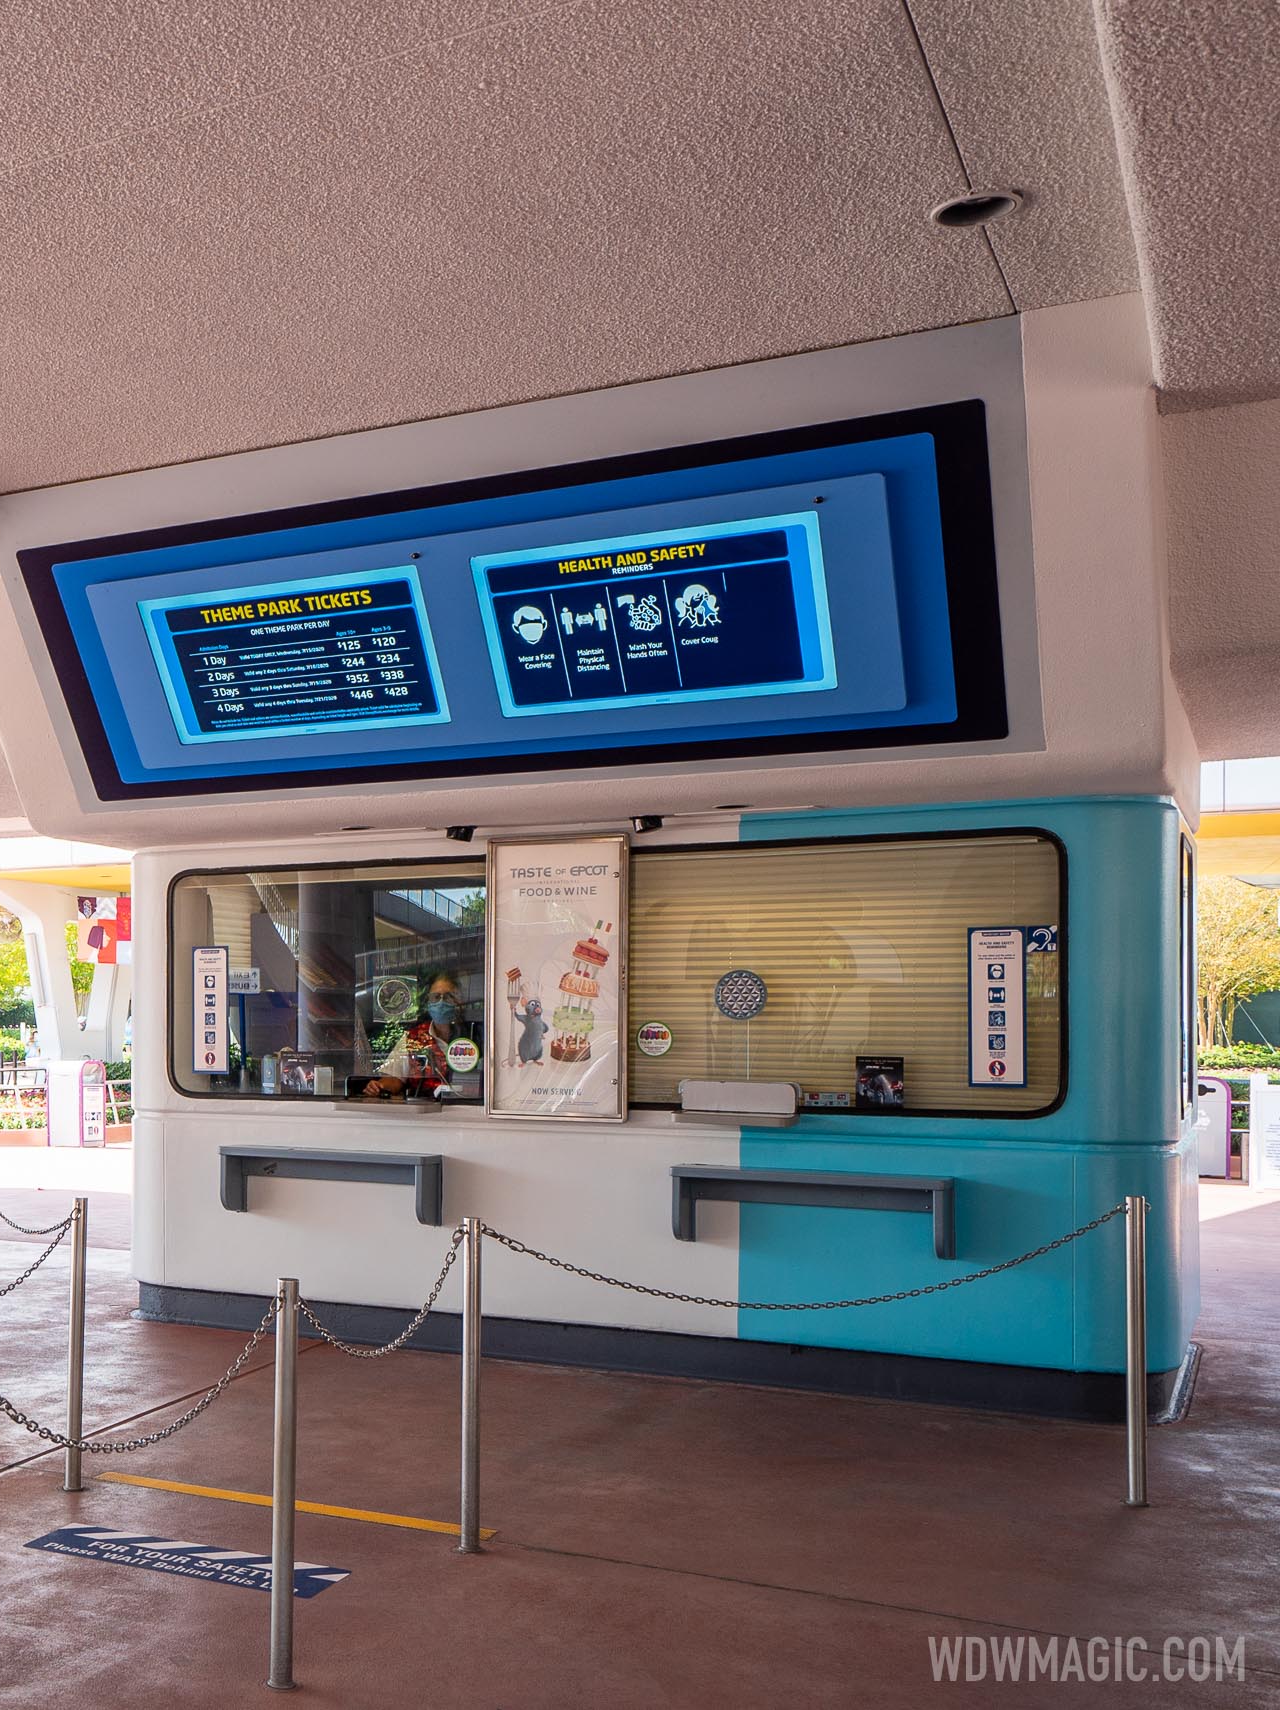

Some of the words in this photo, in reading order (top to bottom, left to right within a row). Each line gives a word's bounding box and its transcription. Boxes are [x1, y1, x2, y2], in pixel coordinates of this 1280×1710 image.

[558, 556, 613, 574] HEALTH
[616, 552, 647, 567] AND
[649, 543, 706, 562] SAFETY
[612, 563, 654, 575] REMINDERS
[200, 604, 255, 624] THEME
[256, 599, 303, 617] PARK
[303, 589, 372, 612] TICKETS
[250, 628, 264, 636] ONE
[264, 625, 286, 635] THEME
[286, 624, 304, 632] PARK
[303, 622, 317, 630] PER
[317, 620, 330, 628] DAY
[628, 643, 647, 651] Wash
[681, 638, 700, 646] Cover
[203, 656, 209, 666] 1
[210, 656, 226, 666] Day
[337, 640, 361, 651] $125
[372, 636, 396, 647] $120
[576, 648, 604, 656] Maintain
[626, 651, 648, 659] Hands
[648, 649, 668, 657] Often
[518, 655, 534, 663] Wear
[540, 653, 555, 661] Face
[579, 655, 605, 665] Physical
[207, 672, 214, 682] 2
[214, 672, 235, 682] Days
[341, 656, 365, 667] $244
[376, 653, 400, 664] $234
[524, 661, 552, 670] Covering
[577, 663, 610, 672] Distancing
[211, 688, 219, 698] 3
[219, 687, 240, 698] Days
[346, 673, 370, 684] $352
[380, 670, 404, 680] $338
[217, 704, 224, 713] 4
[224, 703, 245, 713] Days
[350, 689, 374, 700] $446
[384, 686, 408, 697] $428
[509, 867, 552, 879] TASTE
[569, 864, 609, 877] EPCOT
[519, 887, 553, 897] FOOD
[554, 888, 561, 896] &
[563, 886, 597, 896] WINE
[531, 1087, 549, 1096] NOW
[43, 1542, 98, 1556] Please
[102, 1552, 151, 1565] WAIT
[152, 1561, 215, 1577] Behind
[219, 1573, 255, 1585] This
[88, 1541, 130, 1553] FOR
[135, 1548, 192, 1564] YOUR
[194, 1559, 273, 1579] SAFETY
